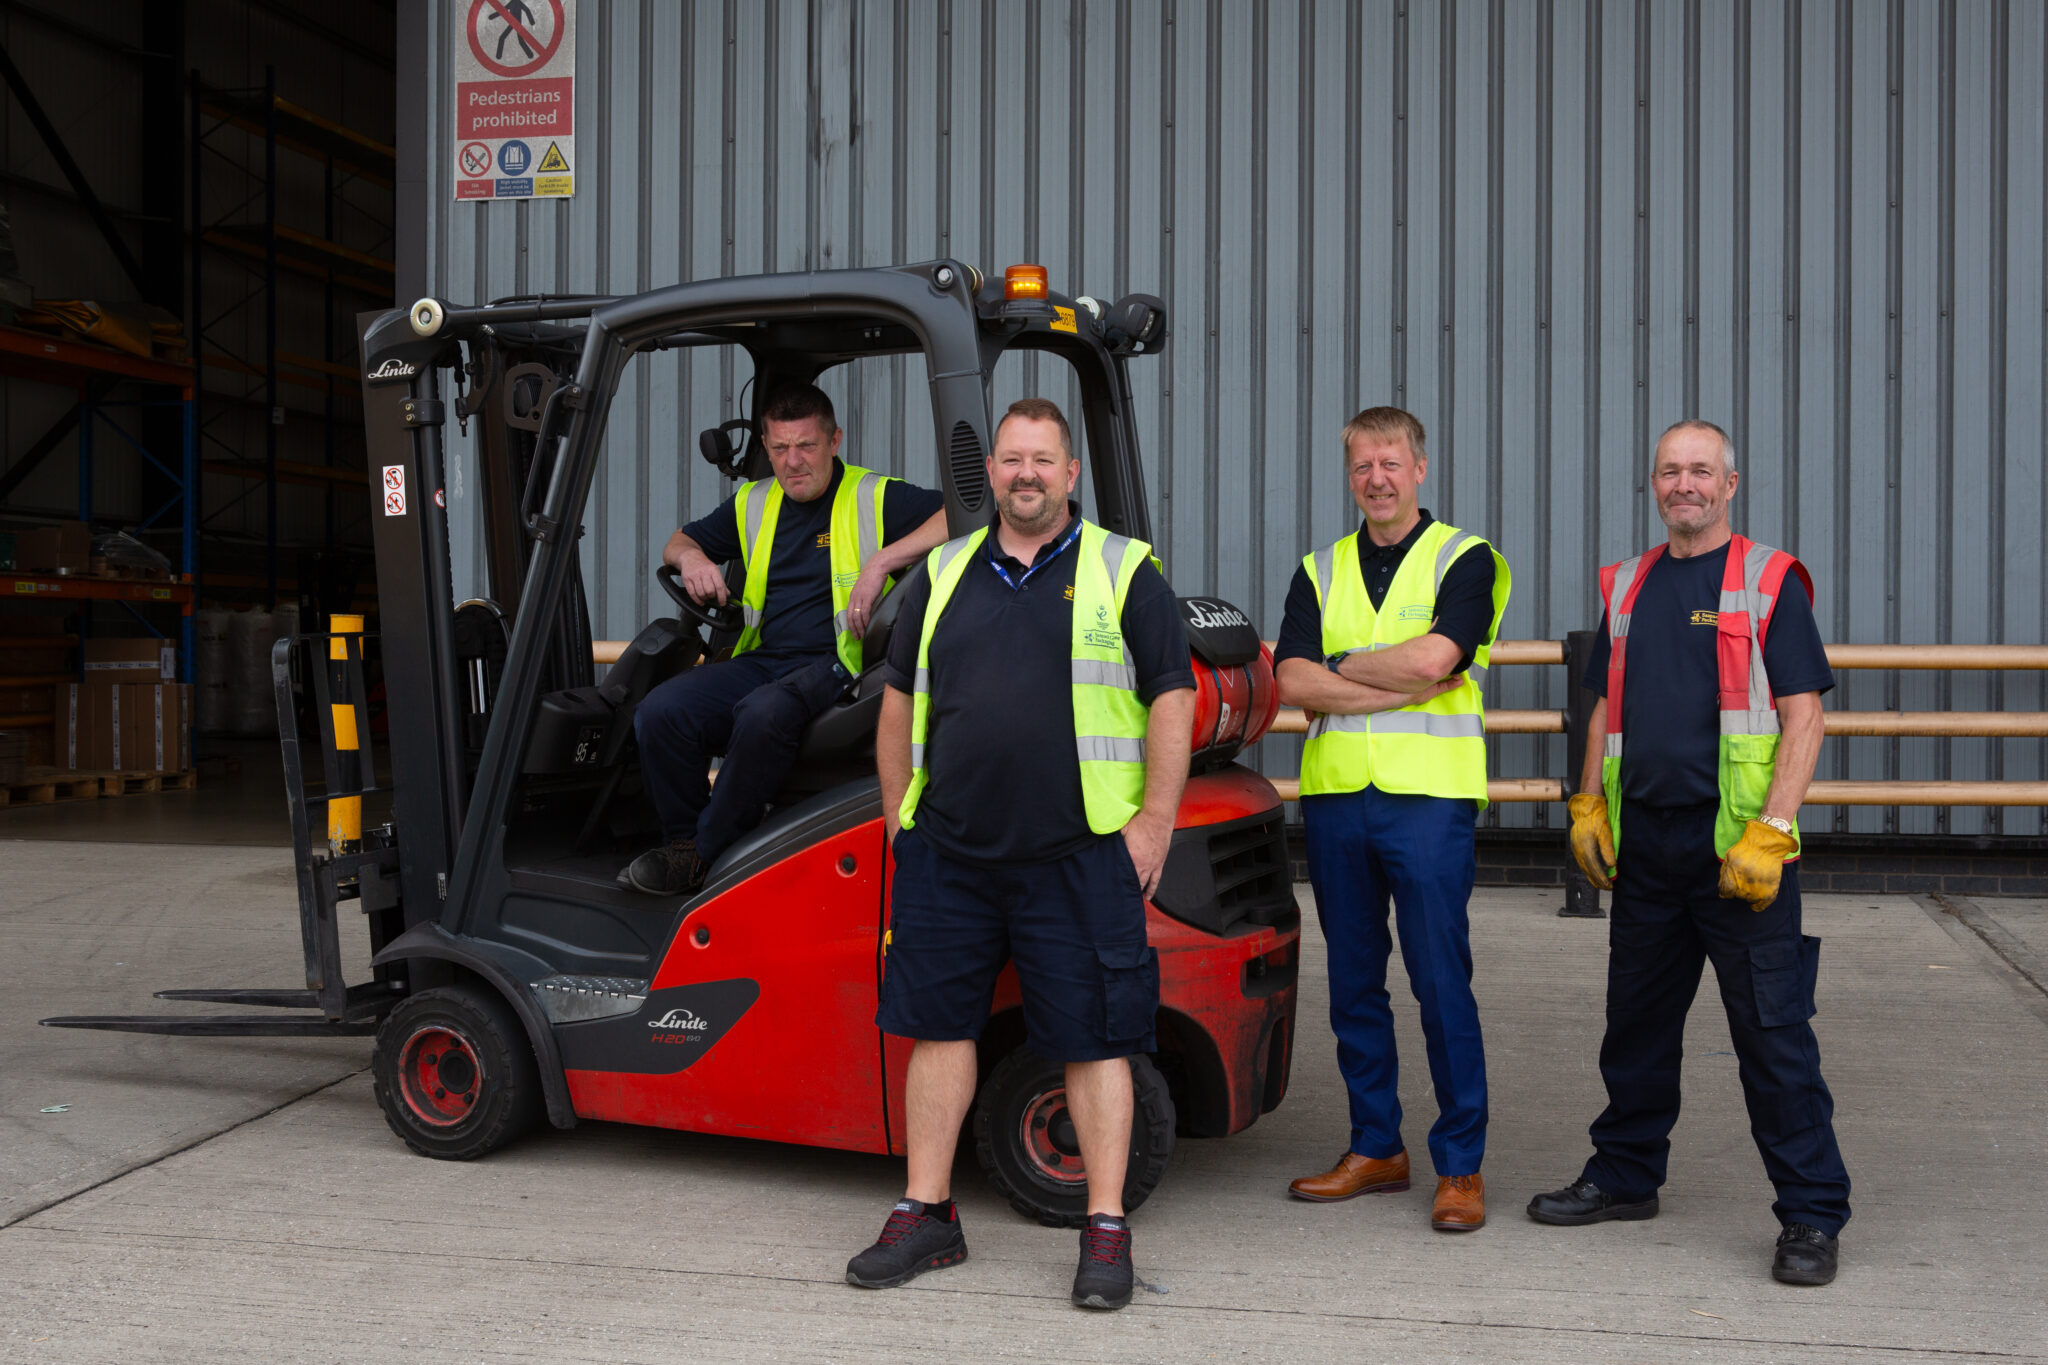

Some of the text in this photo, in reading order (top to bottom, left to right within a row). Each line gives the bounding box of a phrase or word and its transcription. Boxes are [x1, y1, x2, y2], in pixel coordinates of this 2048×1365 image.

[469, 89, 561, 106] Pedestrians
[472, 109, 557, 131] prohibited
[368, 359, 415, 379] Linde
[1186, 600, 1249, 629] Linde
[575, 742, 589, 762] 95
[648, 1008, 708, 1031] Linde
[651, 1033, 686, 1045] H20
